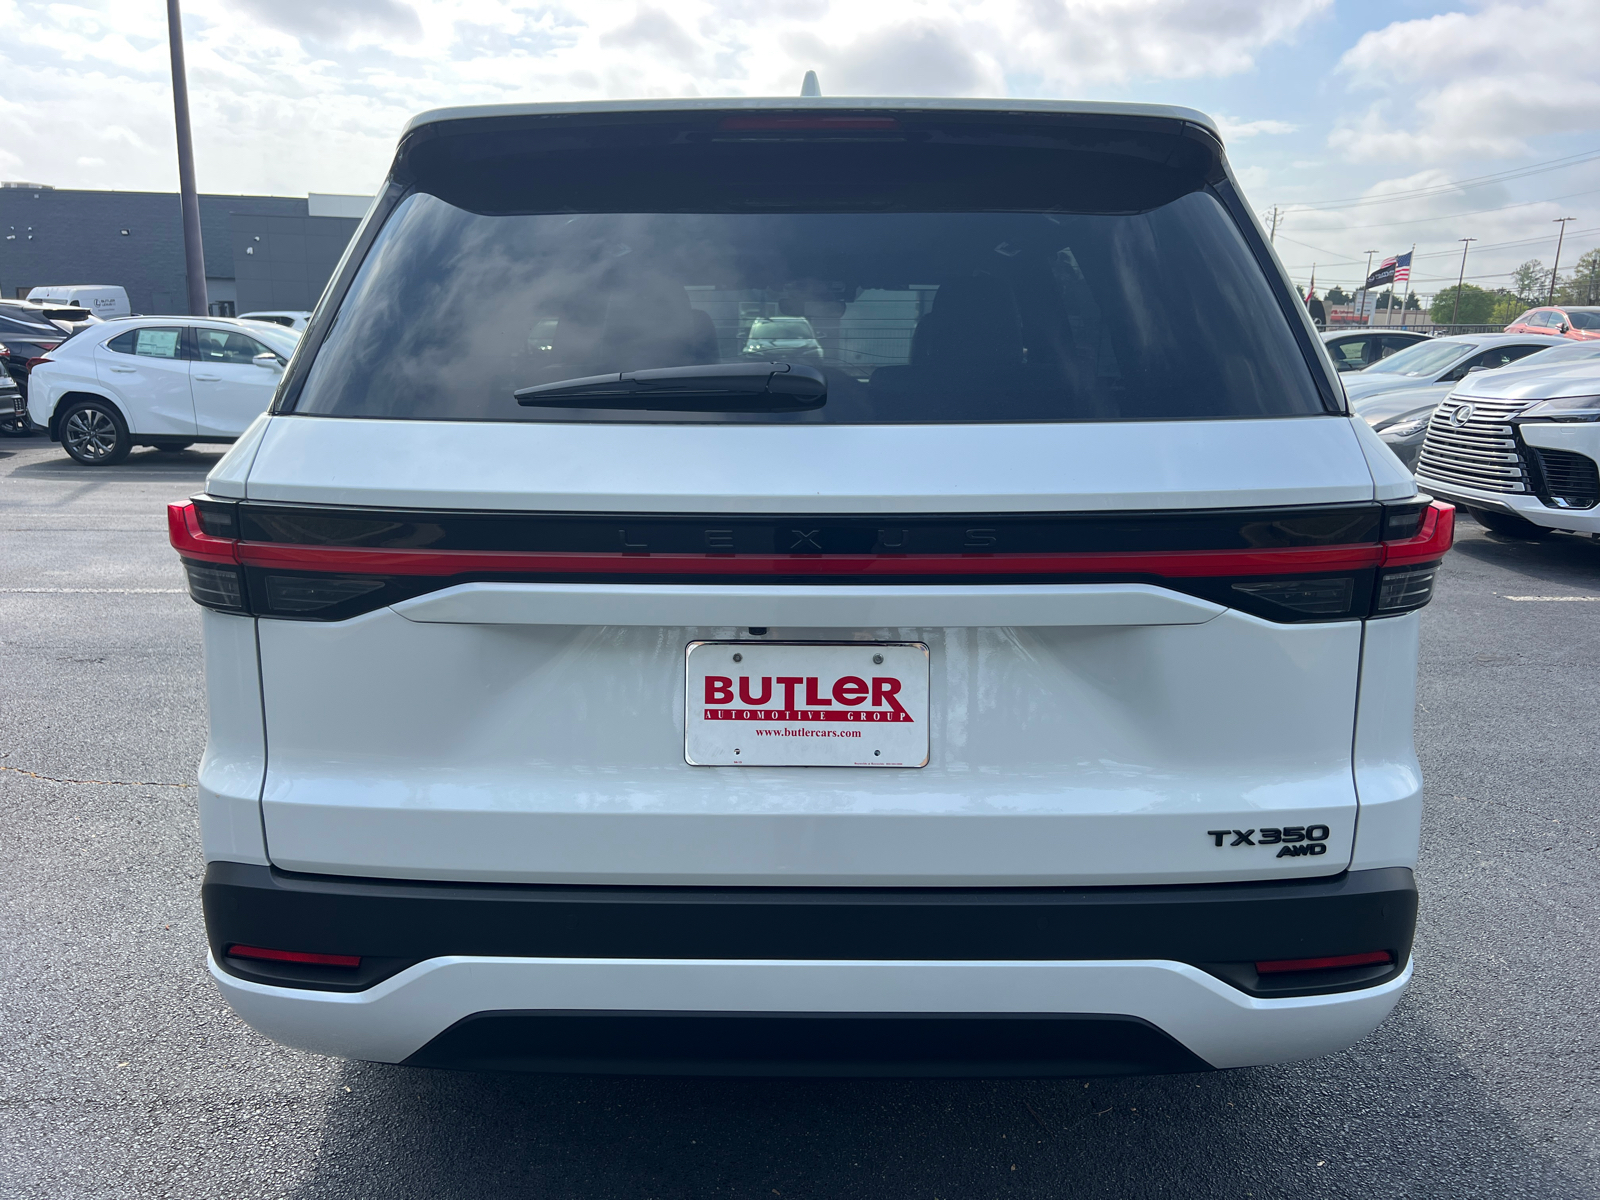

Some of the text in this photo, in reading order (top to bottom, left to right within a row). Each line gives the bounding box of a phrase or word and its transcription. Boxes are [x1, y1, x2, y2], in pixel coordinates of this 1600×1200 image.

[618, 529, 997, 549] LEXUS
[705, 710, 907, 721] AUTOMOTIVE GROUP
[755, 727, 862, 738] www.butlercars.com
[1207, 824, 1330, 847] TX350
[1276, 842, 1327, 858] AWD
